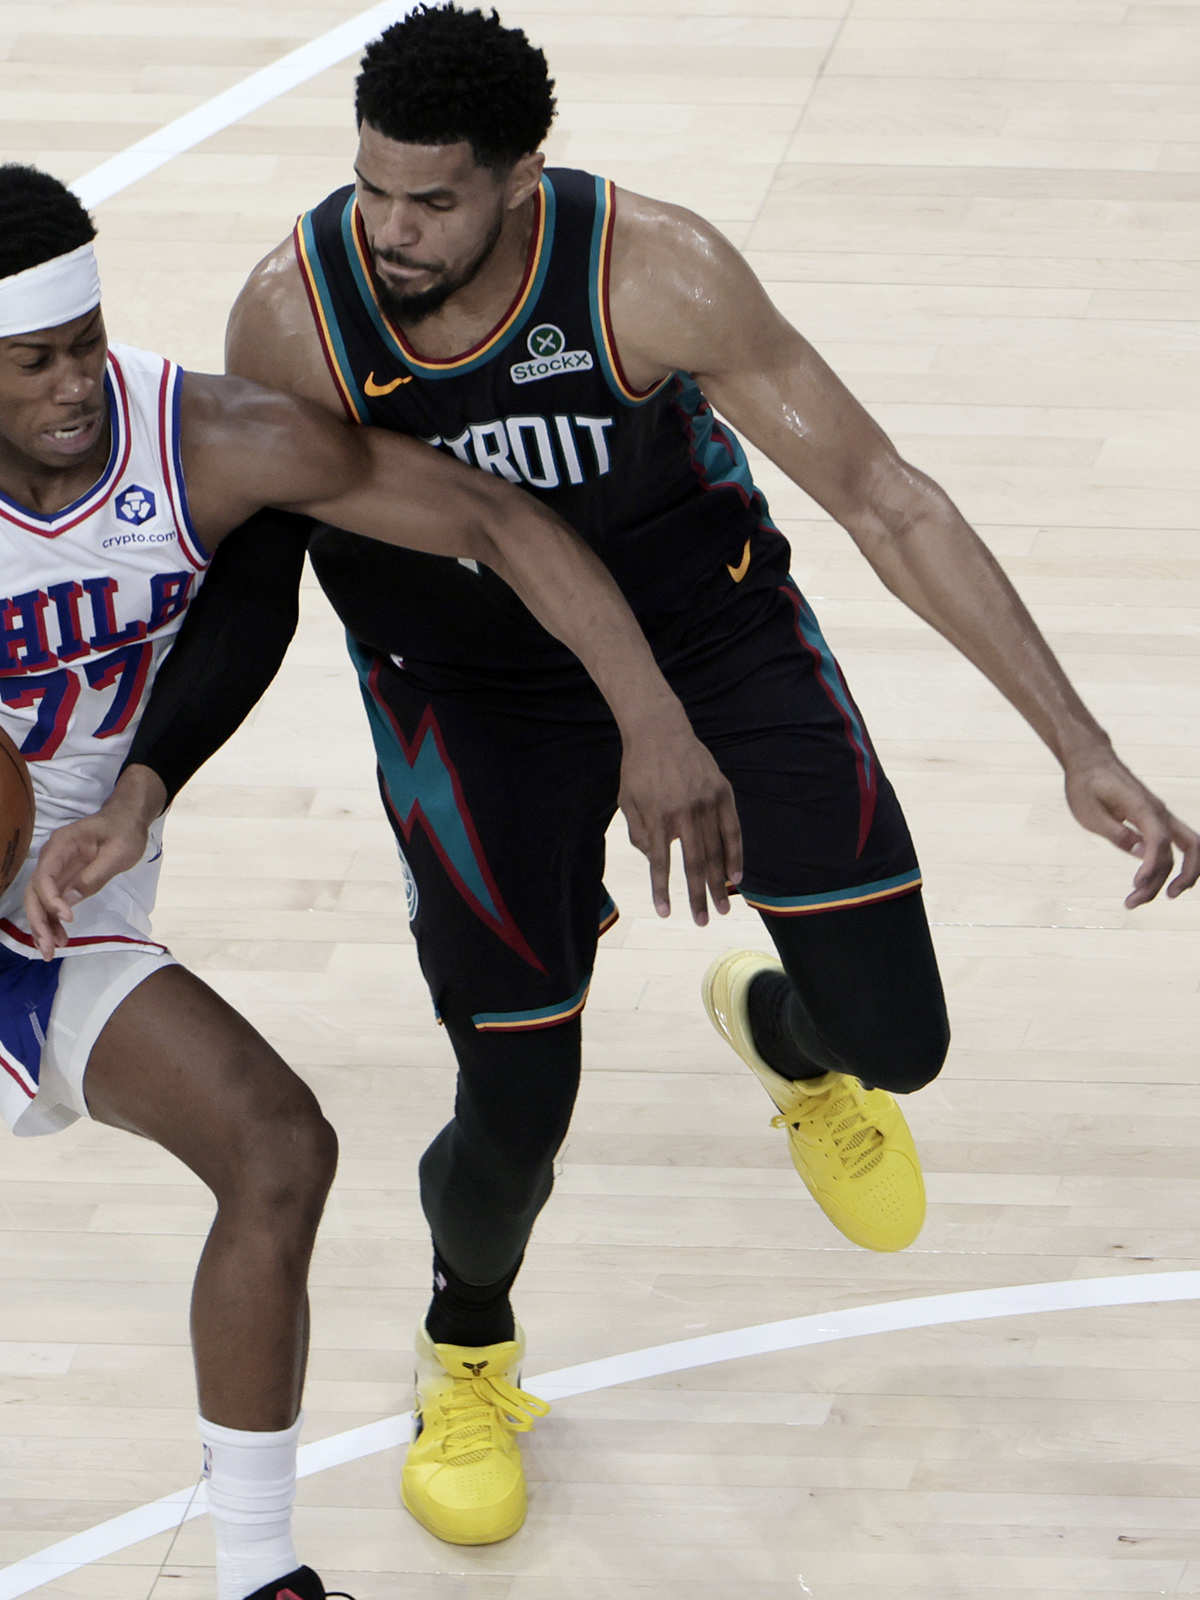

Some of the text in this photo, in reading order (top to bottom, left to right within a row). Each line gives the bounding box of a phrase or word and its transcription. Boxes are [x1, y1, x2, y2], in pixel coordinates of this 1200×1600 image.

[513, 352, 590, 380] StockX
[427, 413, 615, 489] TROIT
[102, 530, 177, 549] crypto.com
